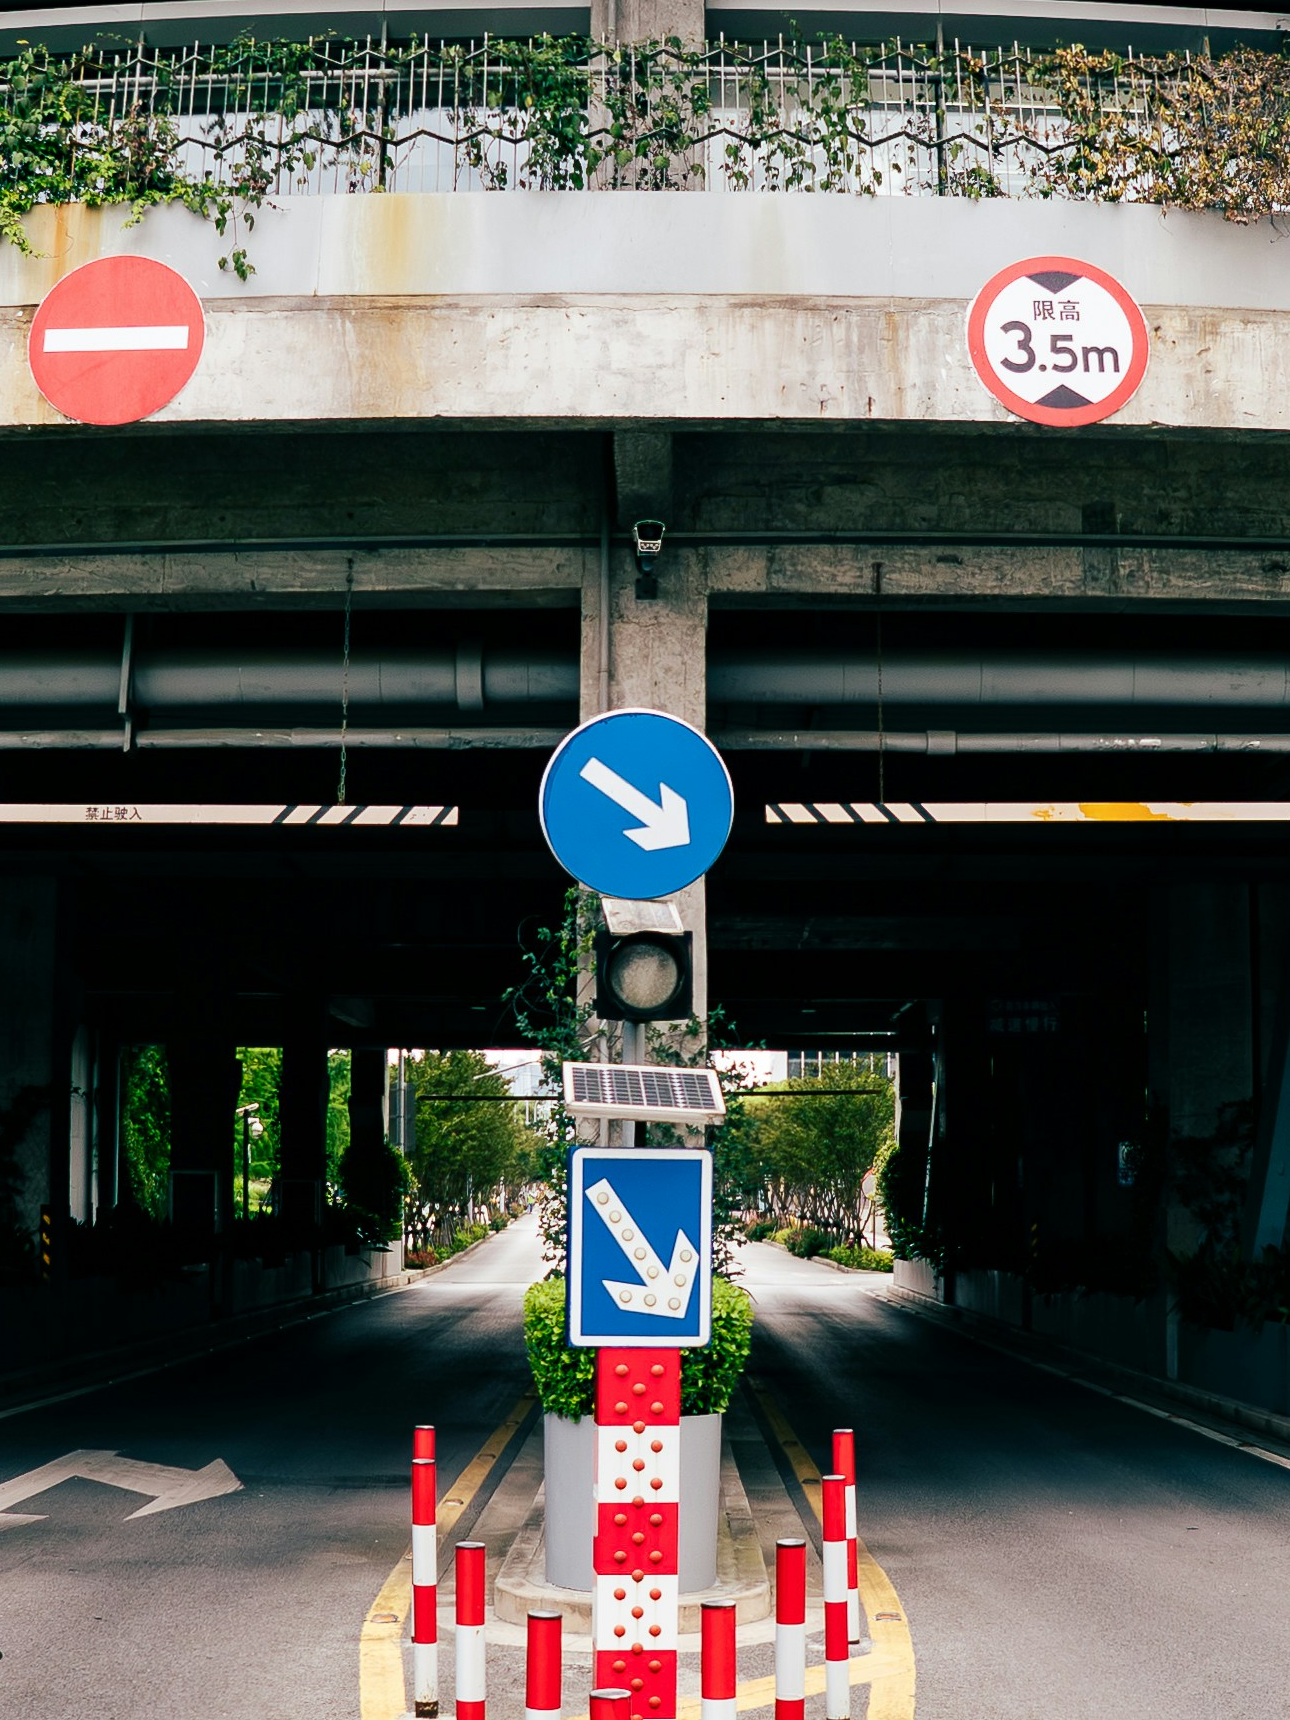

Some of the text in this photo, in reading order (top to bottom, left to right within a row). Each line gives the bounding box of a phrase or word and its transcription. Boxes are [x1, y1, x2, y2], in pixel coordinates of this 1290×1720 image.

[1033, 300, 1080, 321] 限高
[1000, 320, 1120, 373] 3.5m
[85, 807, 142, 821] 禁止驶入
